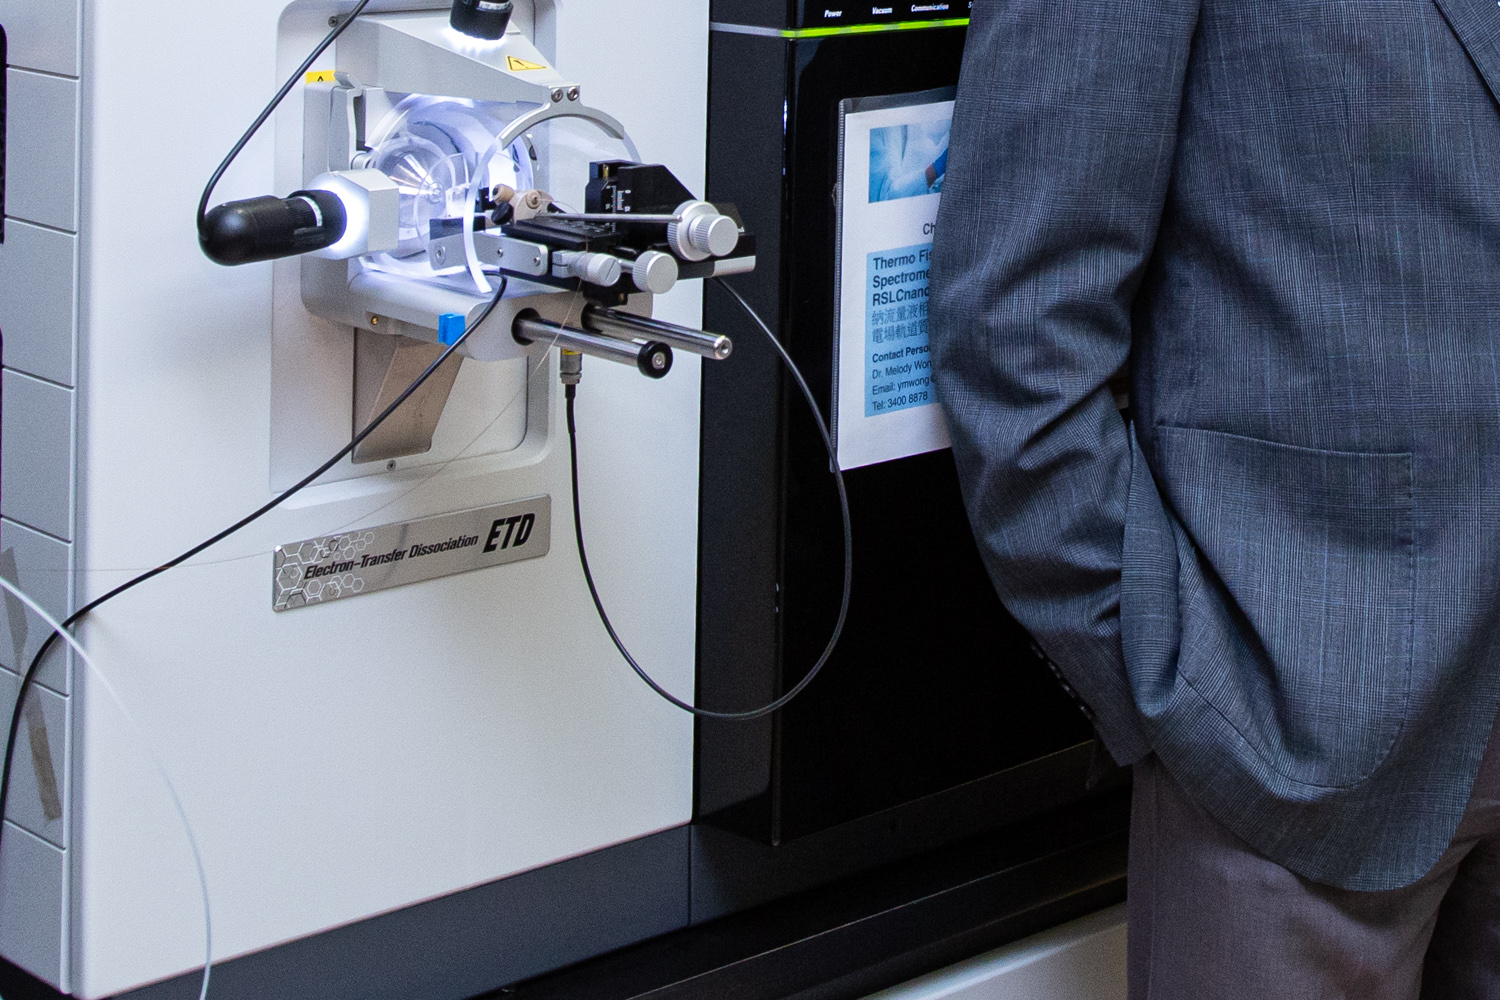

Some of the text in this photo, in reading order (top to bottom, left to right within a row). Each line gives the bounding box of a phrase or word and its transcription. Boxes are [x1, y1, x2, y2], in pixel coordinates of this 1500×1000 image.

[824, 10, 842, 18] Power
[872, 7, 893, 15] Vacuum
[911, 3, 949, 12] Communication
[923, 222, 936, 235] Ch
[873, 254, 916, 270] Thermo
[873, 269, 930, 290] Spectrome
[872, 349, 904, 363] Contact
[872, 360, 932, 379] Dr. Melody Won
[872, 376, 929, 395] Email: ymwong
[872, 391, 928, 411] Tel: 3400 8878
[304, 513, 535, 579] Electron-Transfer Dissociation ETD
